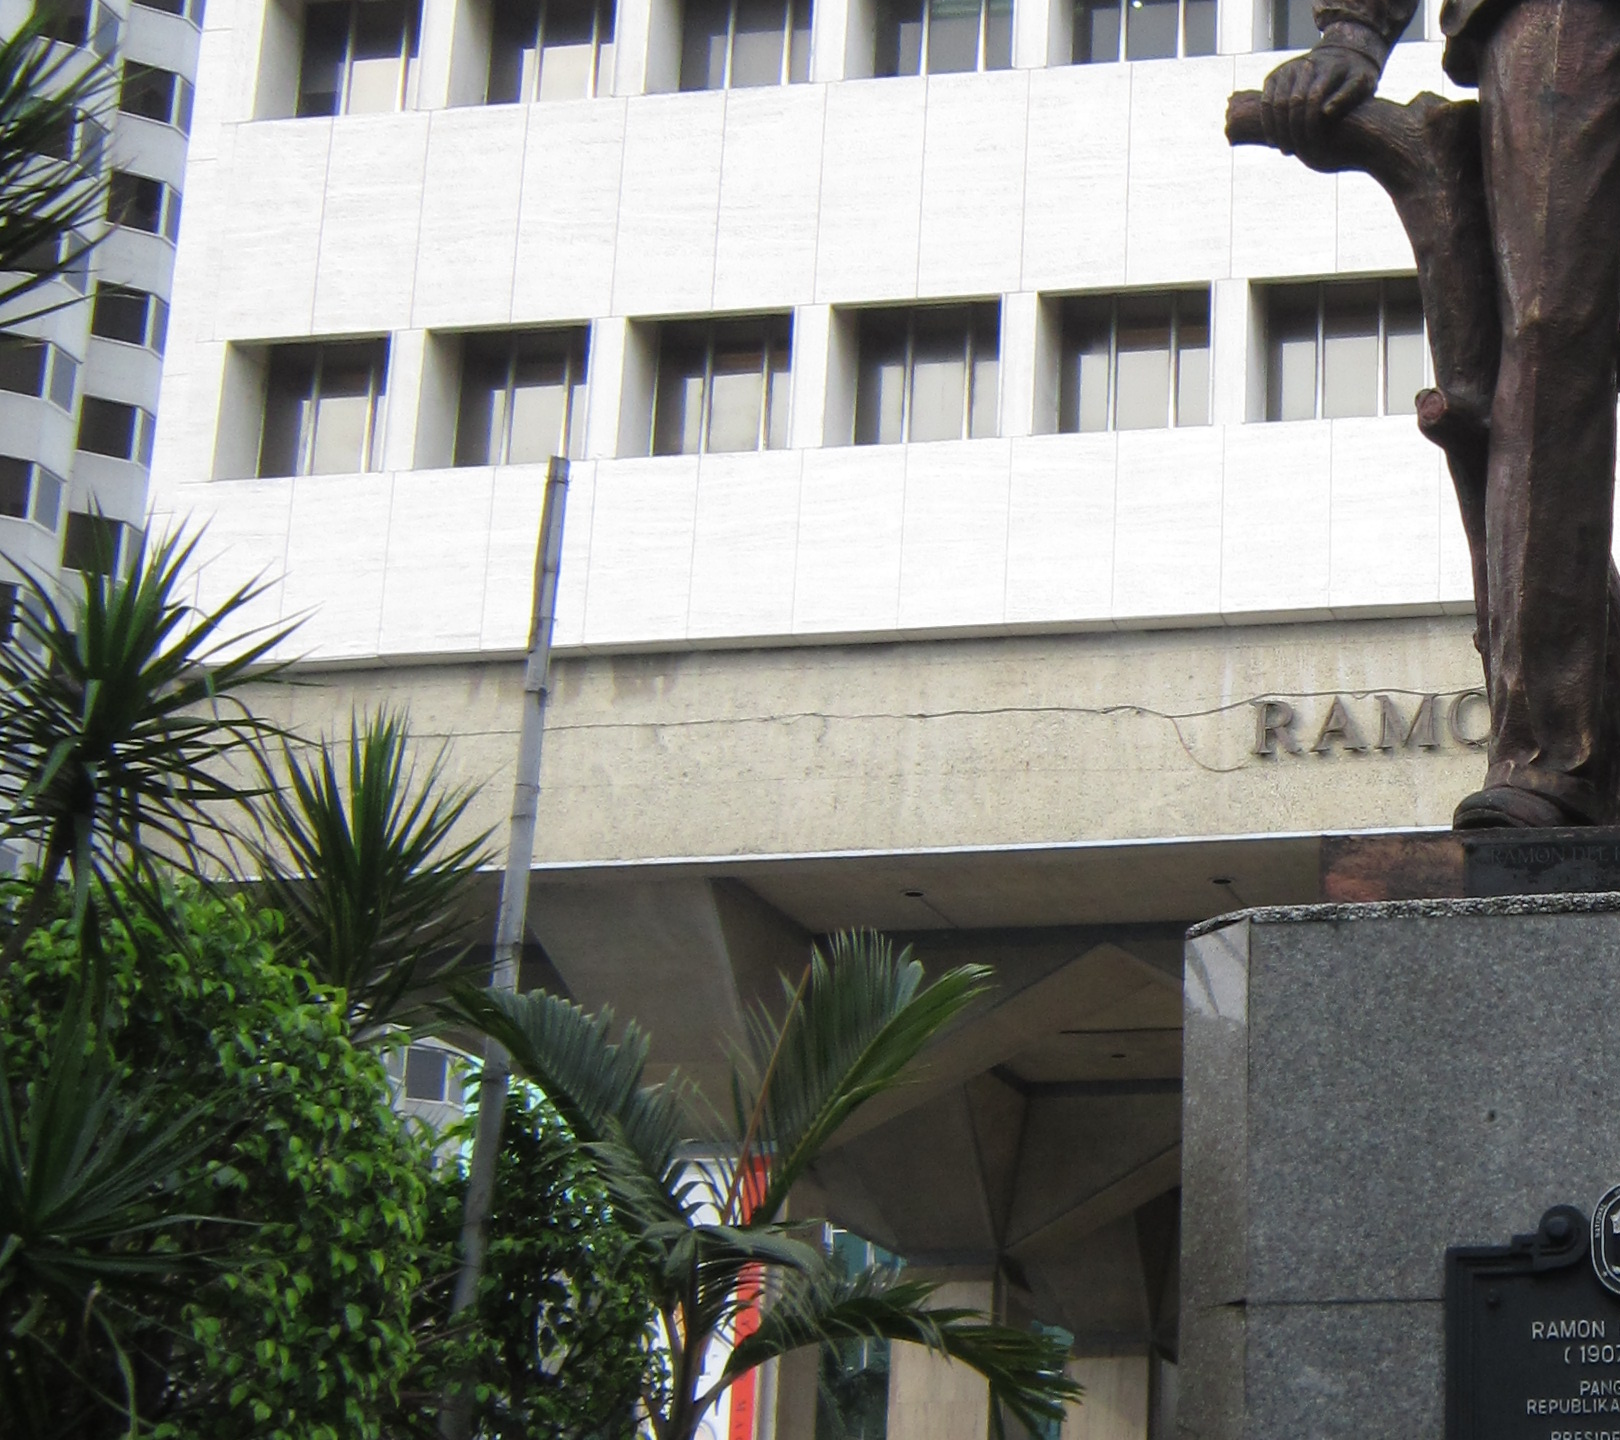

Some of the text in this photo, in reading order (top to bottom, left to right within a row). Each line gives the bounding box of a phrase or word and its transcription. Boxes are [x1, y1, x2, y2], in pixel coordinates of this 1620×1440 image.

[1251, 690, 1492, 756] RAMO
[1491, 844, 1565, 864] RAMON
[1531, 1319, 1606, 1339] RAMON
[1526, 1398, 1620, 1416] REPUBLIKA
